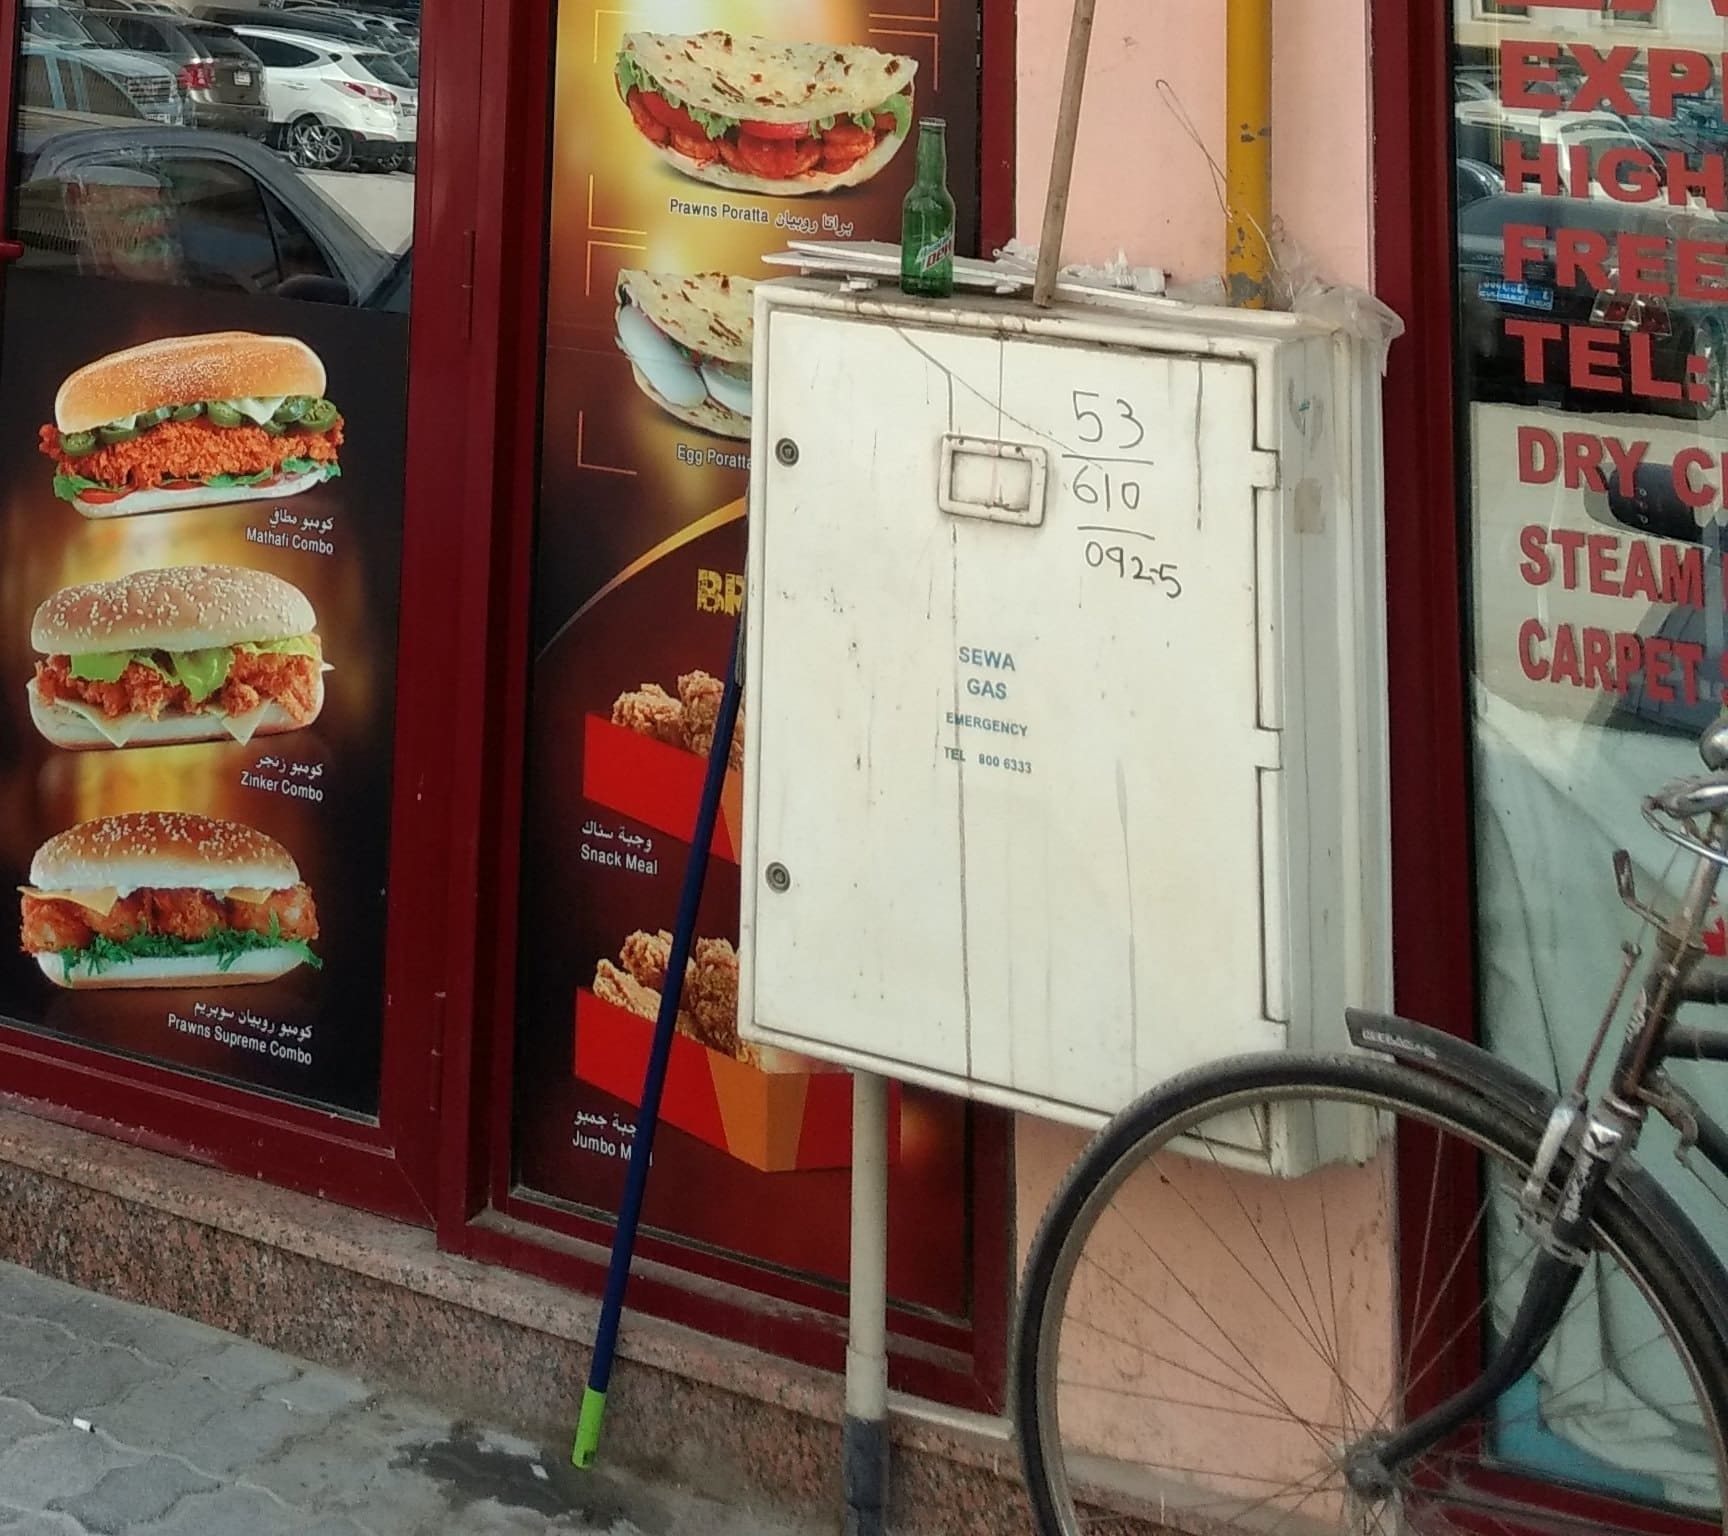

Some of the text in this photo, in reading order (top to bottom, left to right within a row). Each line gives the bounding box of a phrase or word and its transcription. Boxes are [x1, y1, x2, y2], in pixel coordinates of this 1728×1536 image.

[670, 199, 769, 223] Prawns Poratta
[775, 211, 853, 236] براتا روبيان
[1504, 318, 1709, 403] TEL:
[1072, 390, 1144, 449] 53
[677, 444, 703, 466] Egg
[1517, 425, 1650, 498] DRY
[1072, 464, 1140, 513] 610
[246, 527, 334, 555] Mathafi Combo
[1519, 524, 1705, 609] STEAM
[958, 646, 1016, 672] SEWA
[1518, 618, 1705, 706] CARPET
[967, 678, 1007, 700] GAS
[946, 711, 1028, 737] EMERGENCY
[944, 746, 1032, 774] TEL 800 6333
[240, 771, 323, 801] Zinker Combo
[581, 820, 653, 853] وجبة سناك
[580, 843, 658, 875] Snack Meal
[167, 1013, 313, 1065] Prawns Supreme Combo
[574, 1110, 608, 1129] جمبو
[572, 1130, 653, 1167] Jumbo Ml
